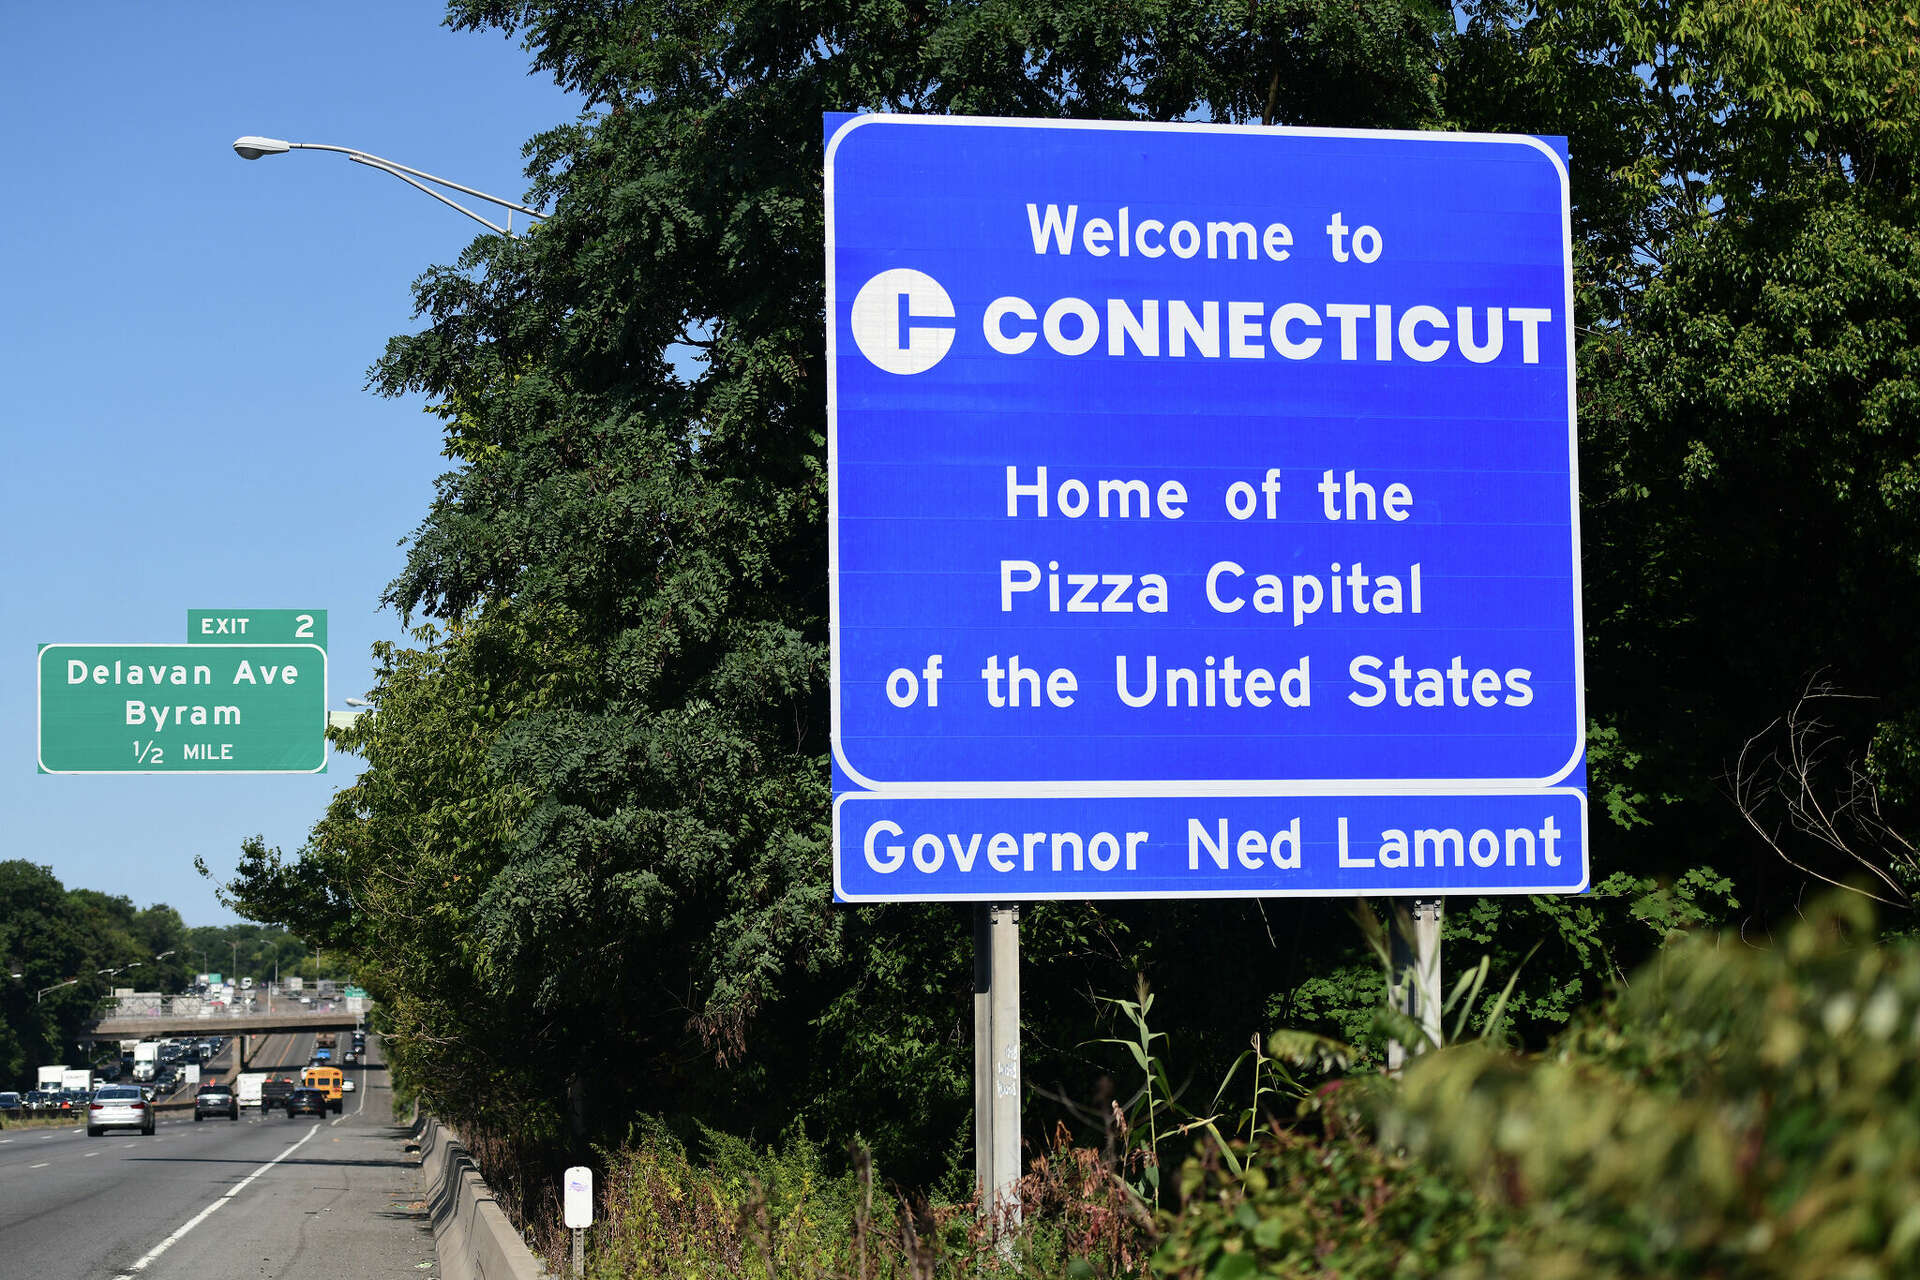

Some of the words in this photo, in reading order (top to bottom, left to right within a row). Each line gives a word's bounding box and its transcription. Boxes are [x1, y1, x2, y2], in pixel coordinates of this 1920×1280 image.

[1027, 204, 1293, 262] Welcome
[1327, 212, 1383, 264] to
[983, 296, 1552, 364] CONNECTICUT
[1006, 466, 1188, 520] Home
[1226, 468, 1281, 521] of
[1318, 470, 1414, 522] the
[1001, 560, 1169, 614] Pizza
[1205, 561, 1422, 627] Capital
[201, 618, 250, 635] EXIT
[295, 614, 314, 638] 2
[67, 660, 211, 685] Delavan
[233, 660, 298, 685] Ave
[886, 654, 943, 708] of
[982, 655, 1079, 708] the
[1116, 655, 1311, 708] United
[1348, 655, 1534, 708] States
[126, 700, 241, 732] Byram
[183, 744, 233, 760] MILE
[864, 819, 1150, 874] Governor
[1188, 817, 1302, 870] Ned
[1337, 816, 1562, 869] Lamont
